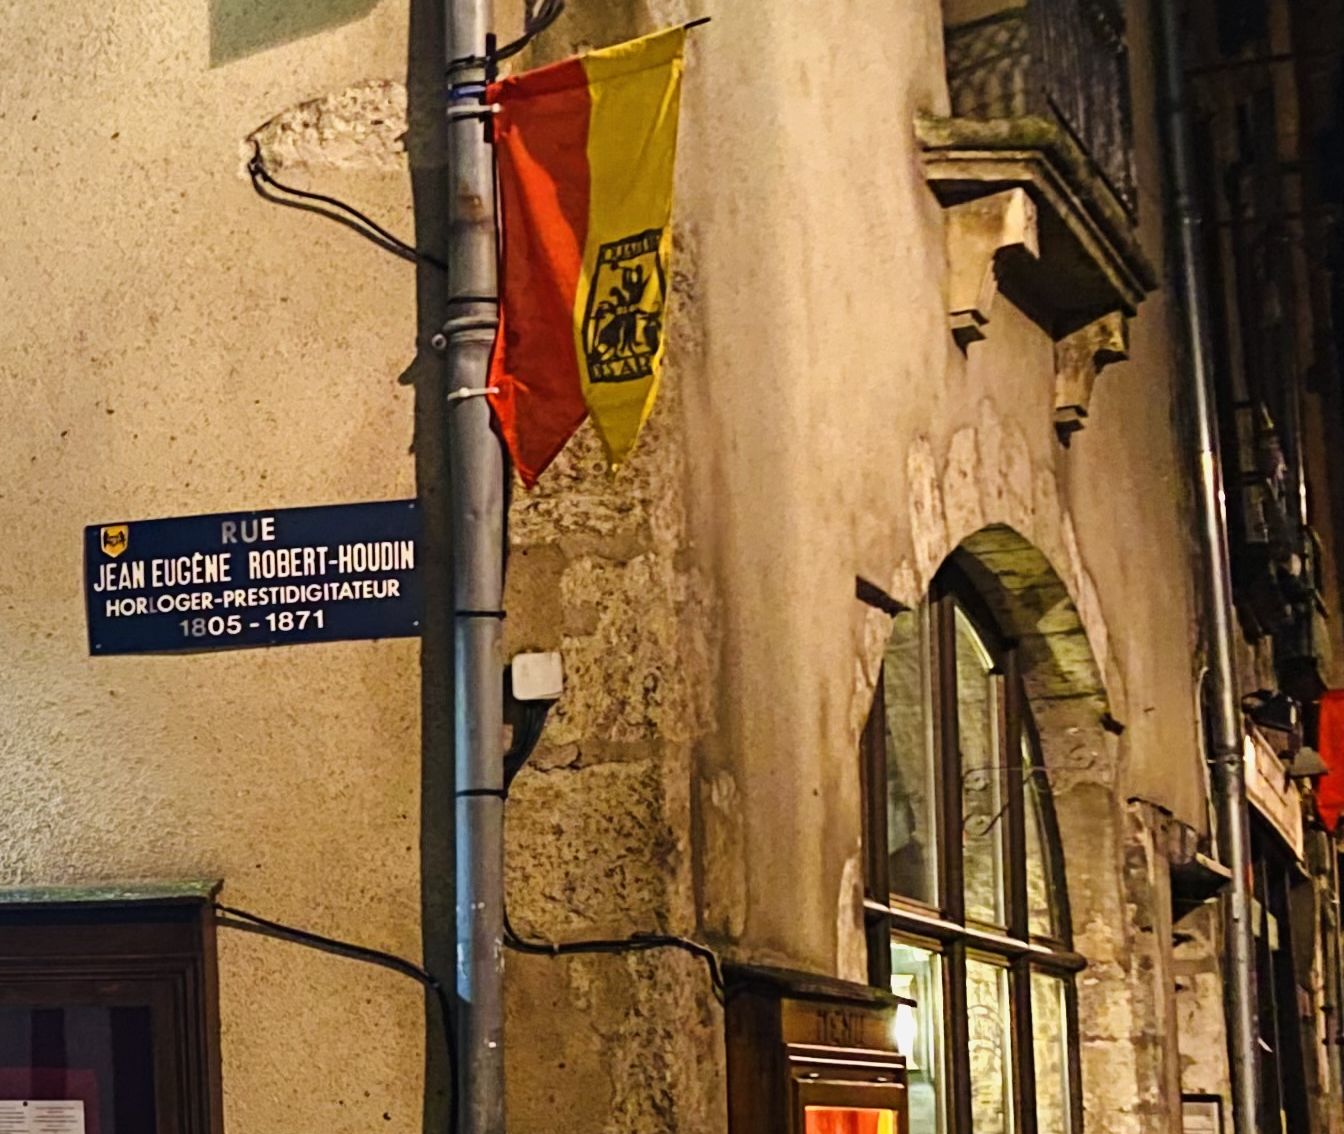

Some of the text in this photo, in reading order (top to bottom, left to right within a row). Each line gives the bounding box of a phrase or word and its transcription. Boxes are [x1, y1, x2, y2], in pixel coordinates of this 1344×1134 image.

[221, 517, 276, 544] RUE
[93, 560, 145, 592] JEAN
[248, 540, 415, 580] ROBERT-HOUDIN
[105, 579, 401, 618] HORLOGER-PRESTIDIGITATEUR
[179, 614, 243, 637] 1805
[268, 610, 325, 632] 1871
